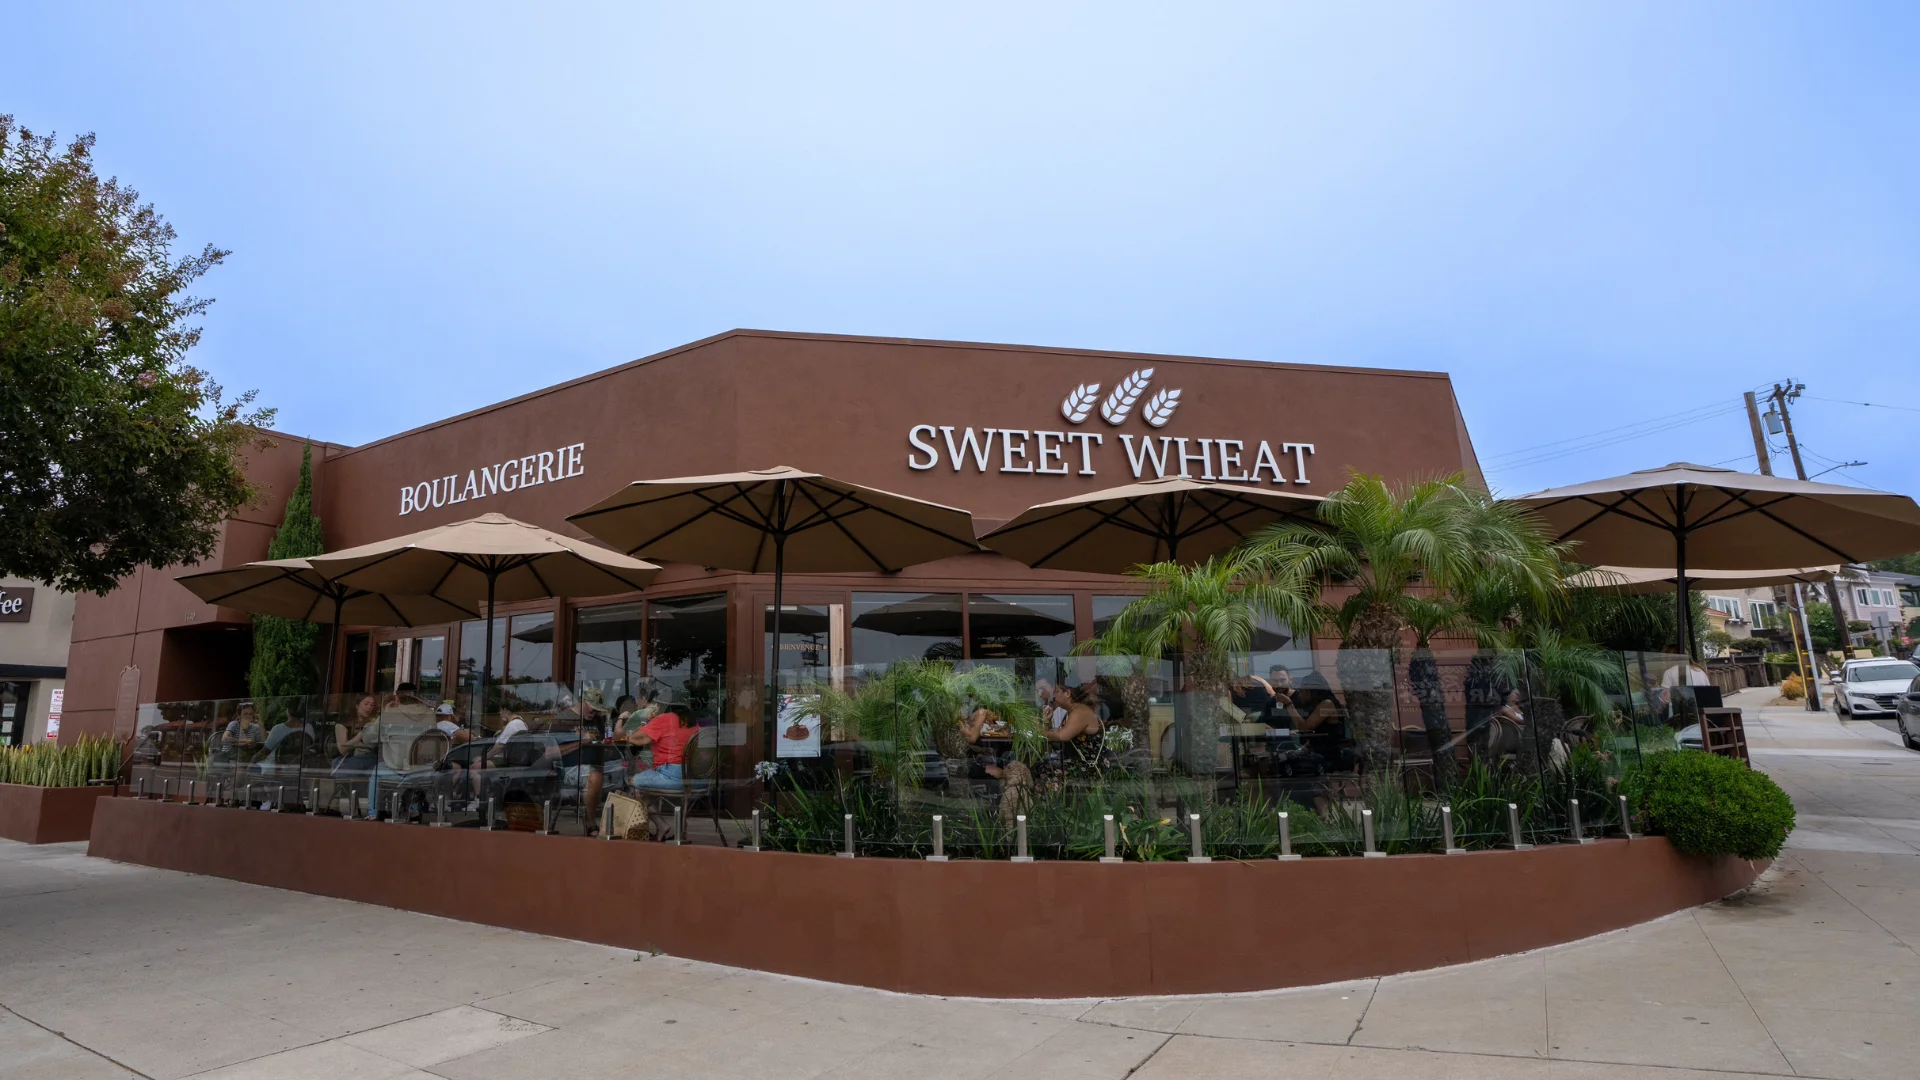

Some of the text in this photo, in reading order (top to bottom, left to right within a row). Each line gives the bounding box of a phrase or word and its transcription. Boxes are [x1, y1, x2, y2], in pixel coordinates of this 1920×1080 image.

[399, 442, 585, 516] BOULANGERIE
[908, 424, 1316, 484] SWEET WHEAT
